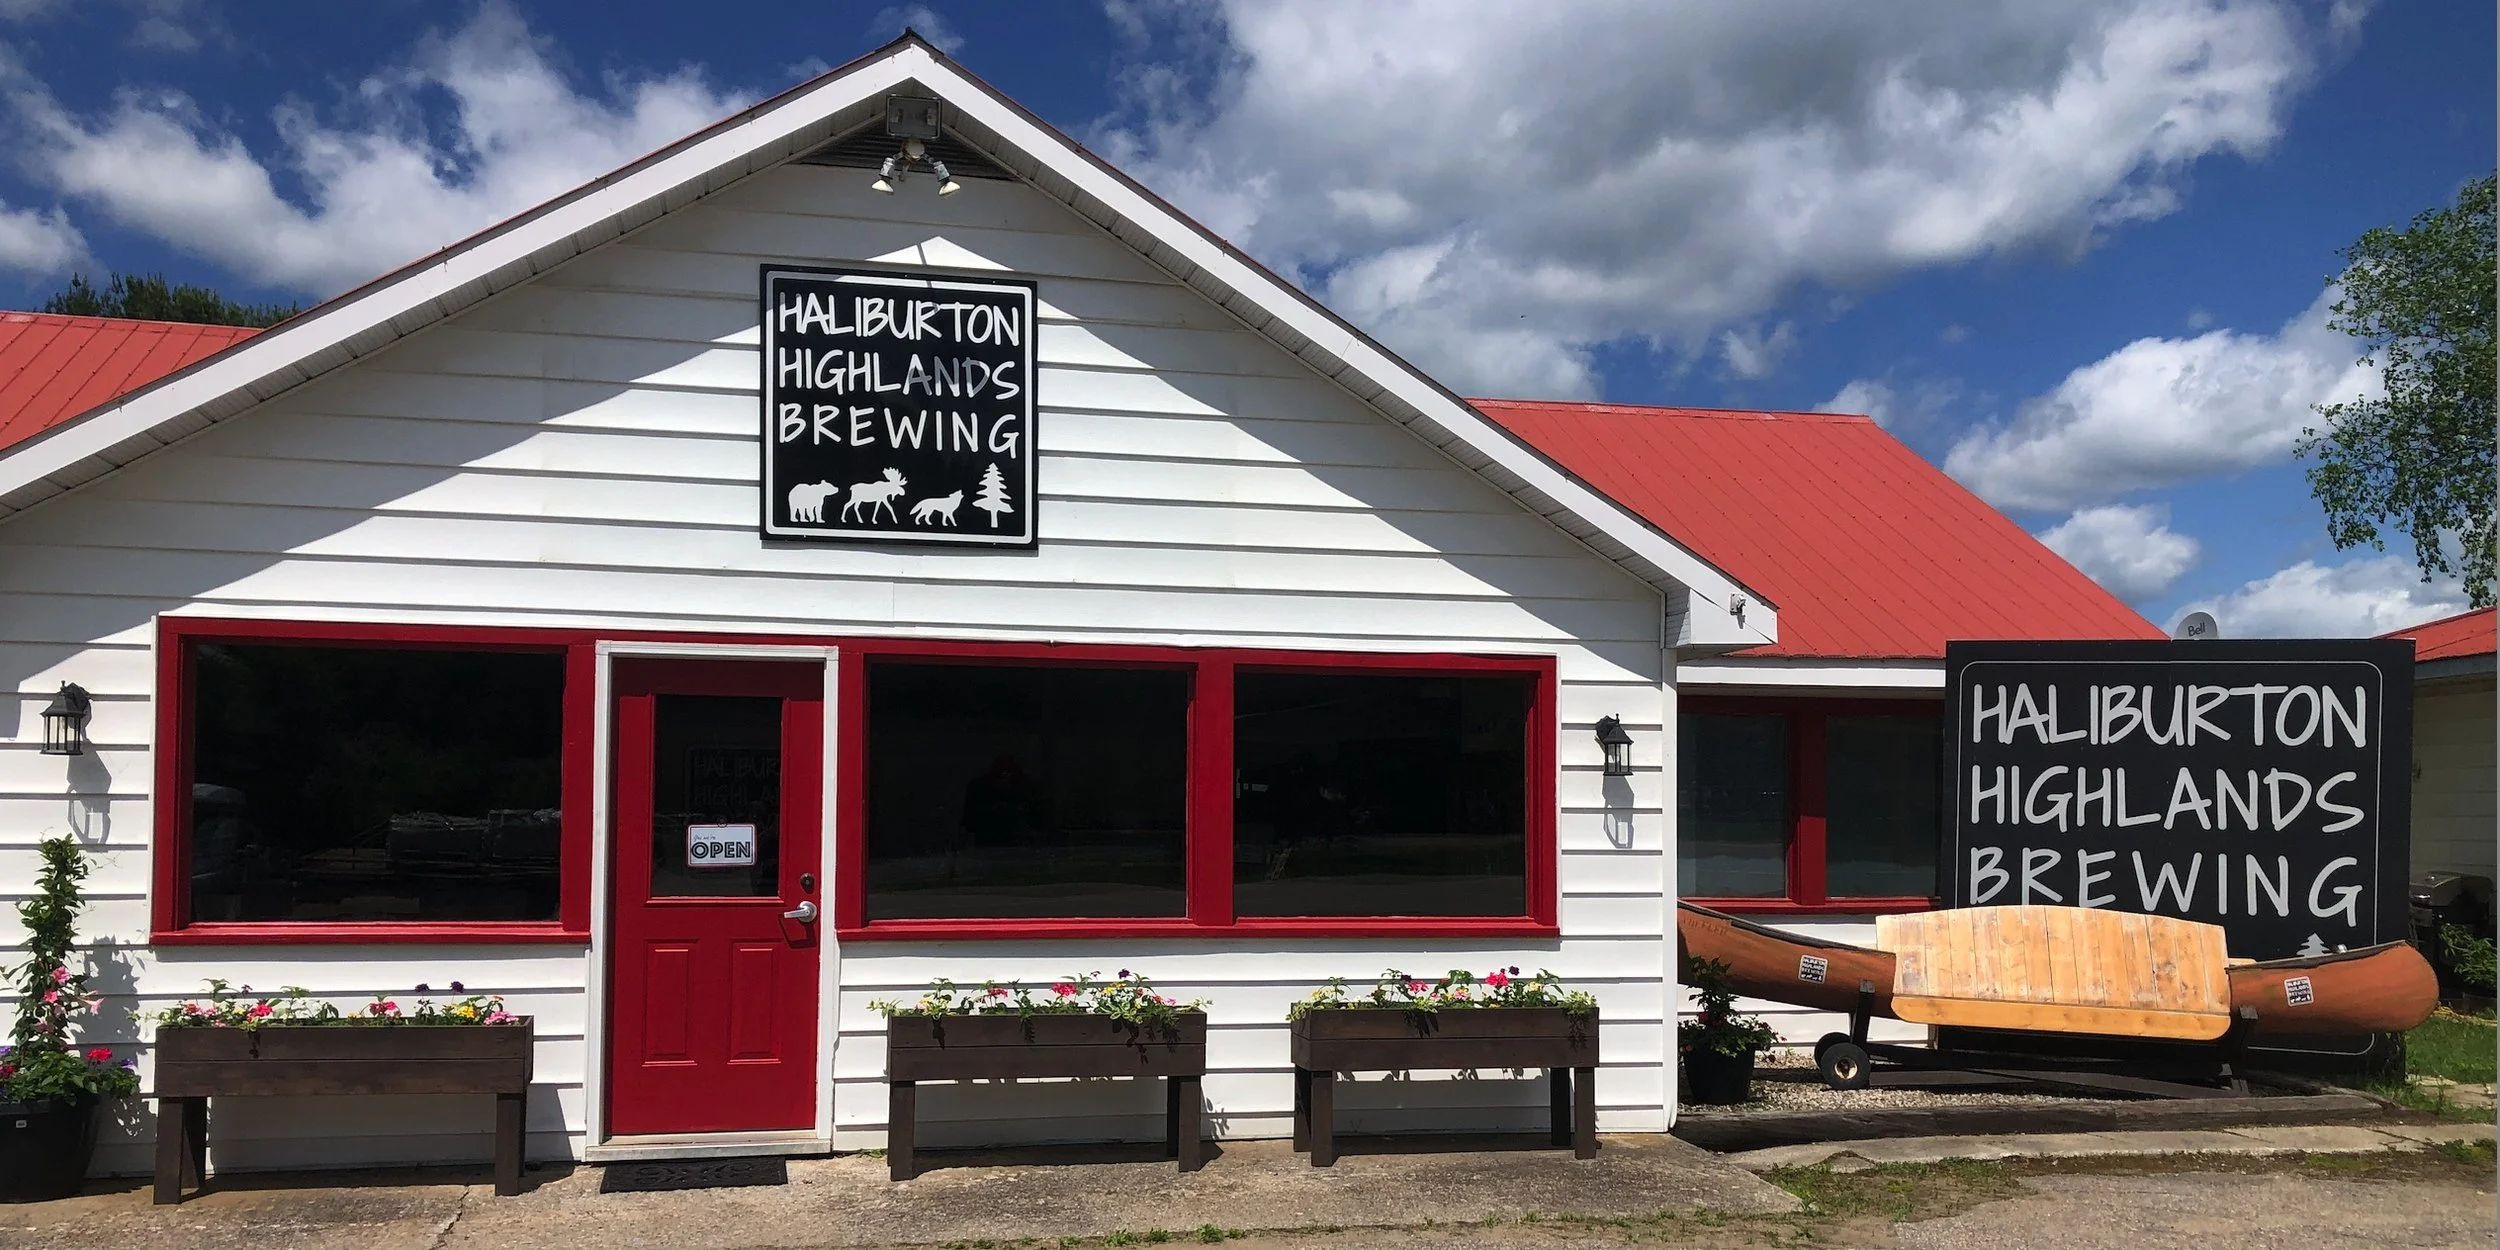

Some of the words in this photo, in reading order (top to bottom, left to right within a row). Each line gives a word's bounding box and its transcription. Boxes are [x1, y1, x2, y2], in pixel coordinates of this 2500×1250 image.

[780, 292, 1019, 346] HALIBURTON
[780, 347, 1020, 400] HIGHLANDS
[779, 403, 1020, 459] BREWING
[2187, 622, 2206, 637] Bell
[1972, 683, 2367, 748] HALIBURTON
[1971, 765, 2365, 833] HIGHLANDS
[691, 841, 751, 859] OPEN
[1969, 847, 2363, 927] BREWING
